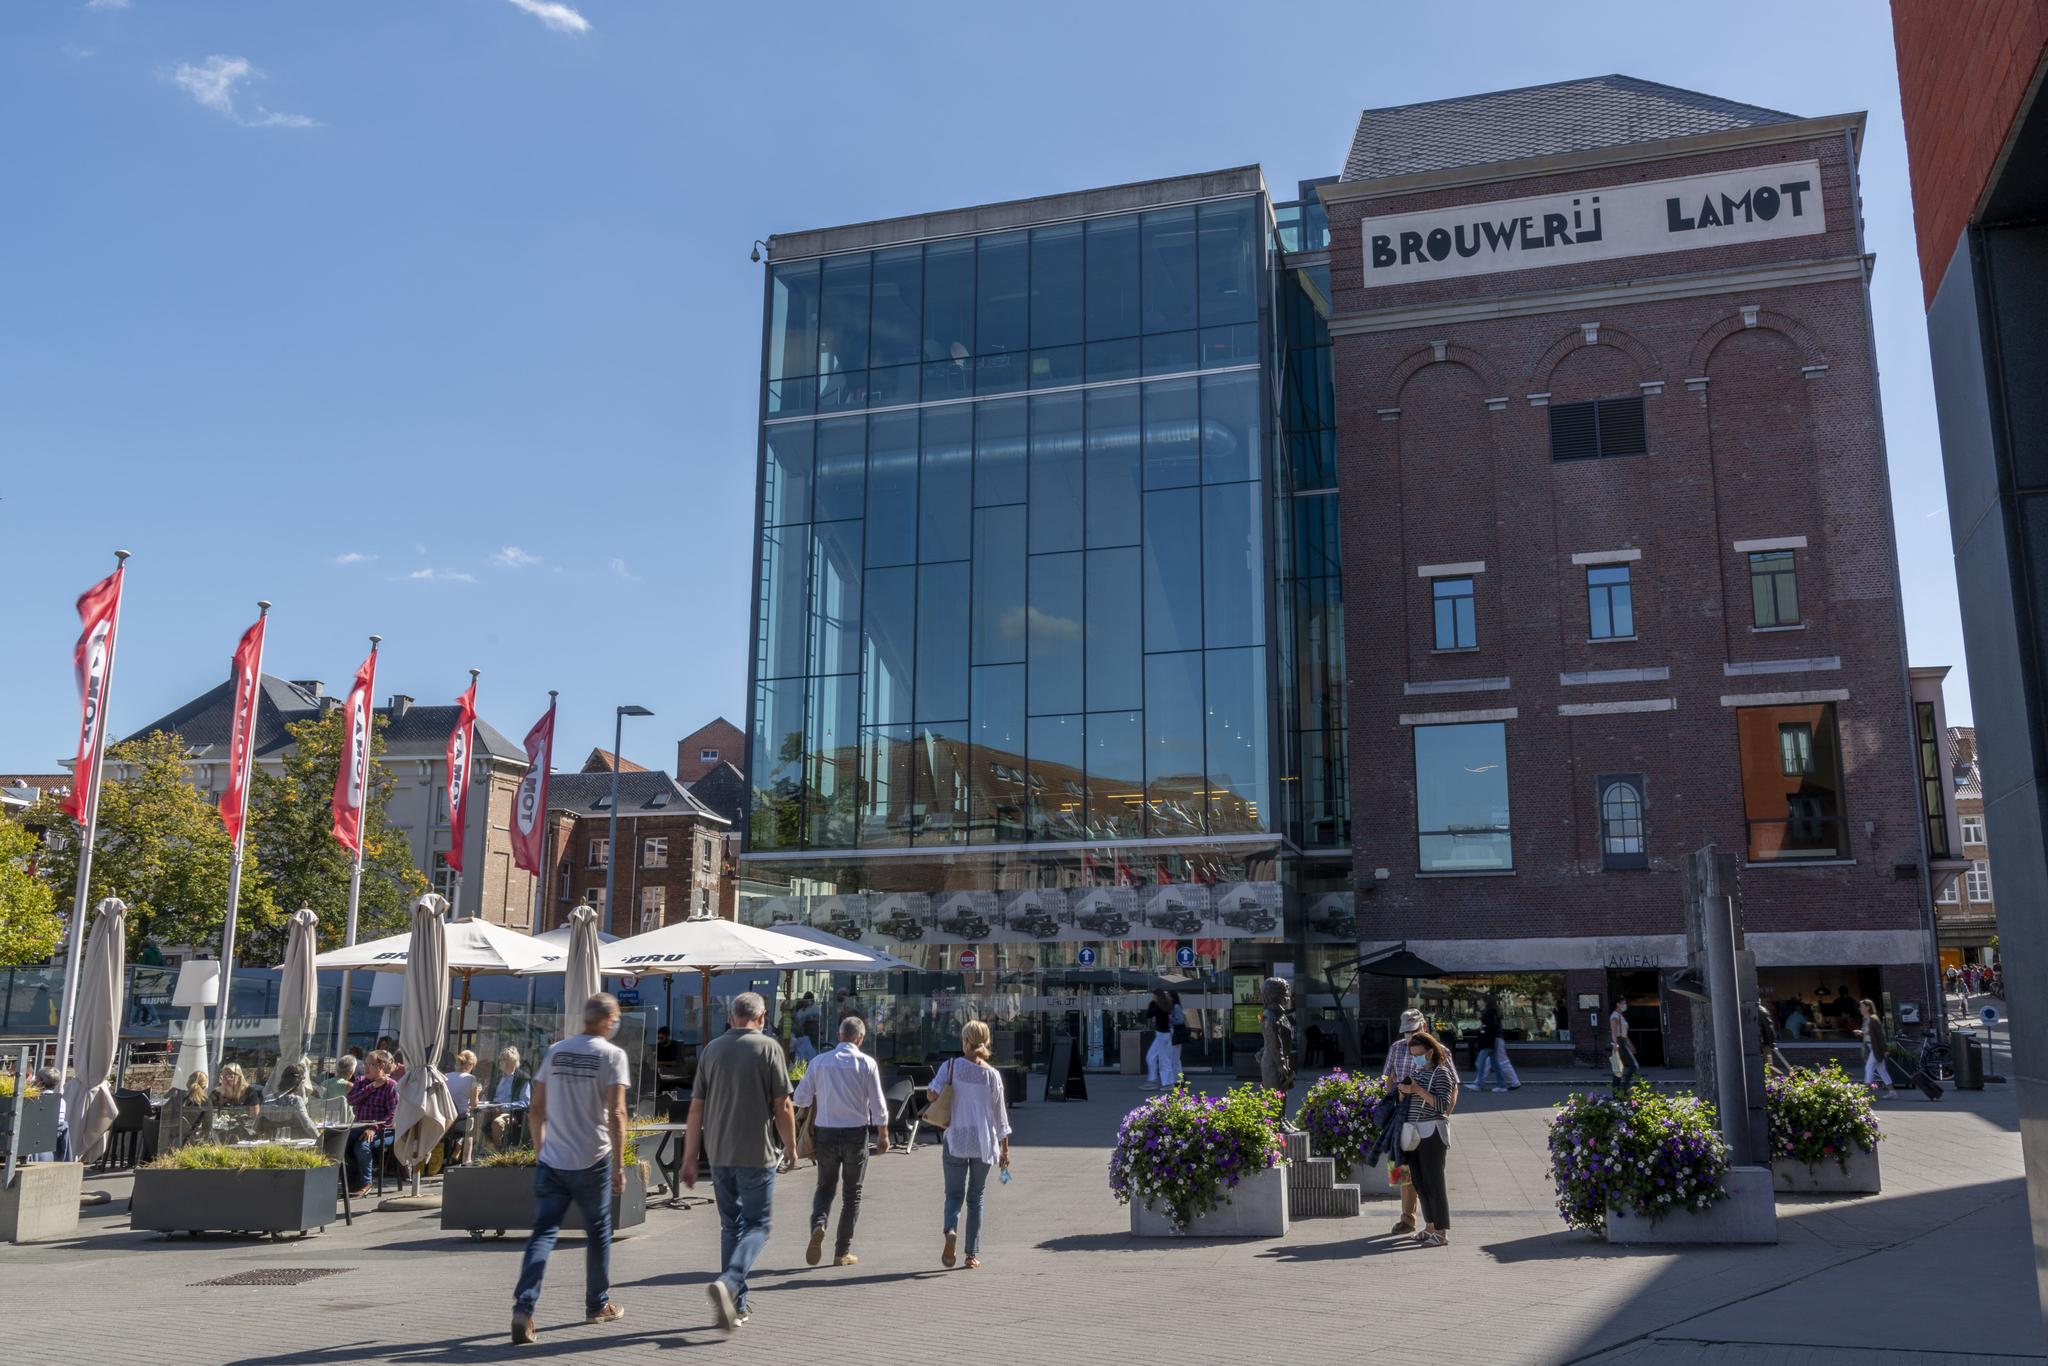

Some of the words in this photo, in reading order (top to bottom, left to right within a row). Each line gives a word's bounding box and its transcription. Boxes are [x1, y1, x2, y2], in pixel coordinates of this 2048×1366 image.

[1665, 180, 1811, 233] LAMOT
[521, 763, 540, 824] AMOT
[372, 951, 409, 960] BR
[624, 953, 686, 964] BRU
